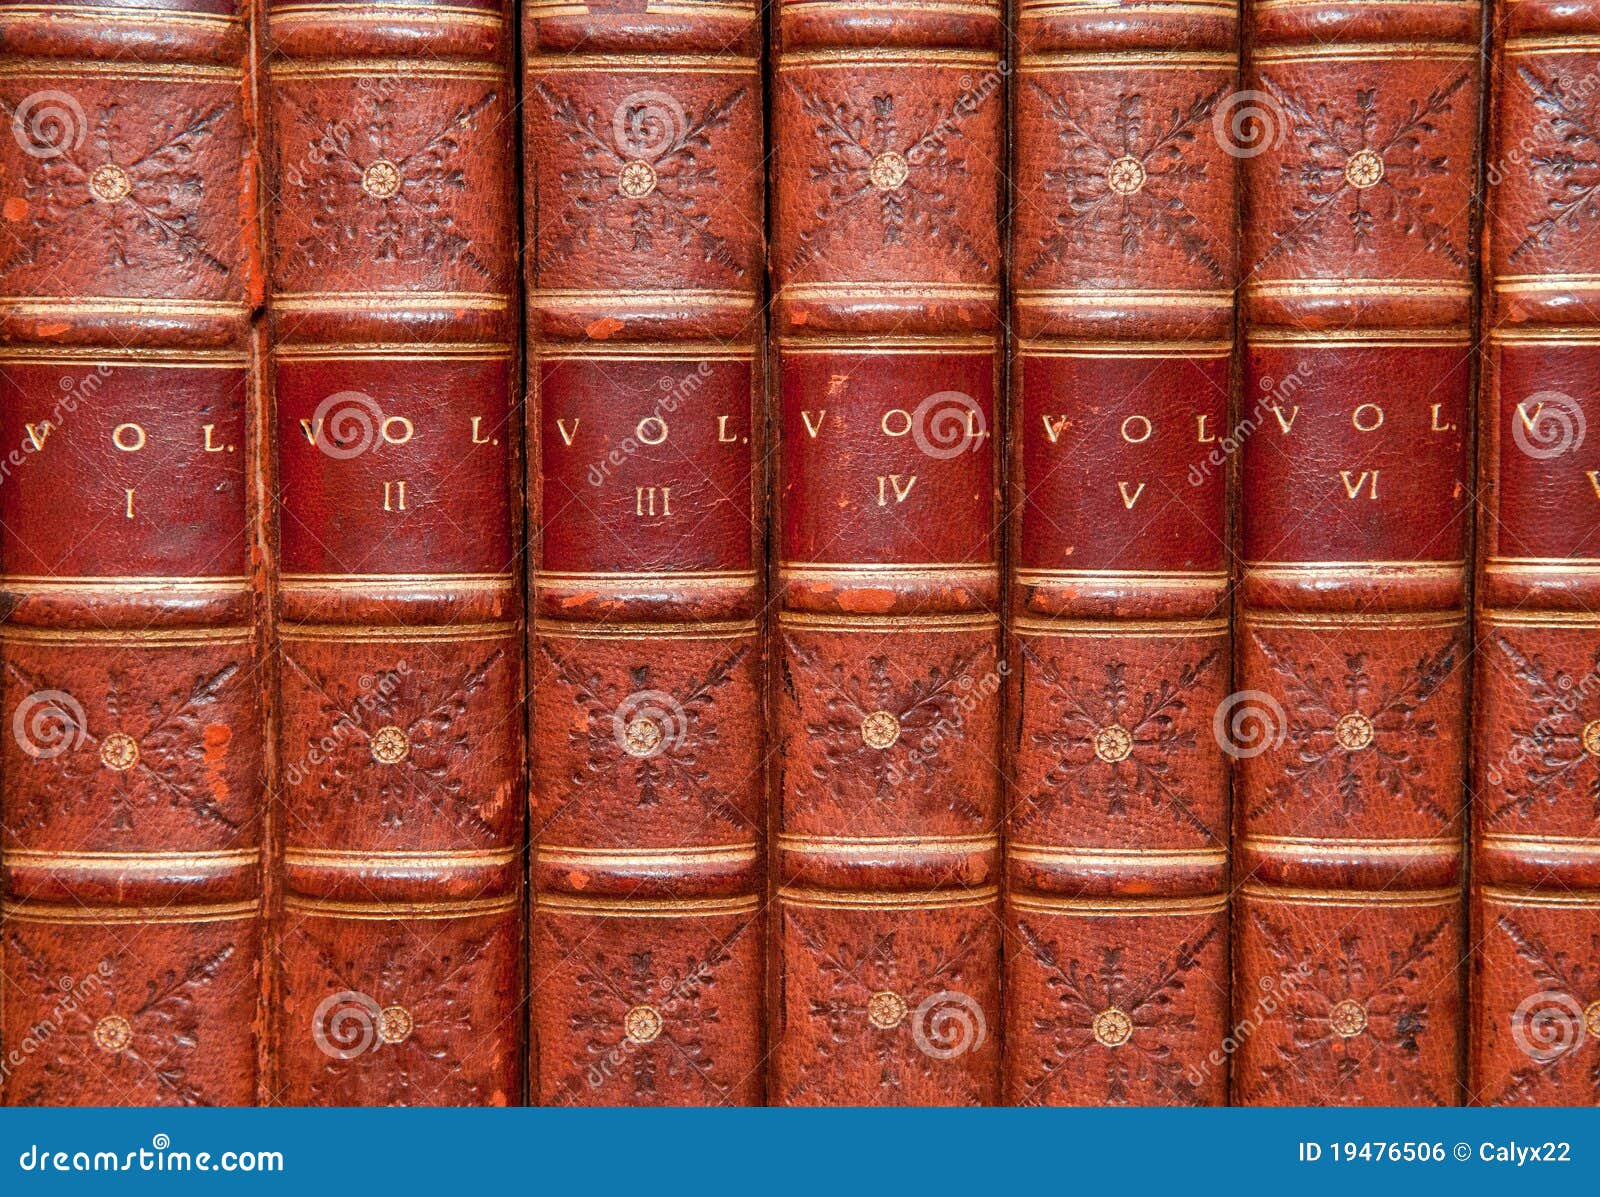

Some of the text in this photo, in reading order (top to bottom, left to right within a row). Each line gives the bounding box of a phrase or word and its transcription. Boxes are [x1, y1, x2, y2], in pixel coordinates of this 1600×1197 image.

[384, 481, 406, 511] II
[876, 474, 918, 507] IV
[1118, 481, 1145, 509] V
[1340, 470, 1378, 500] VI
[125, 488, 136, 518] I
[635, 487, 672, 517] III
